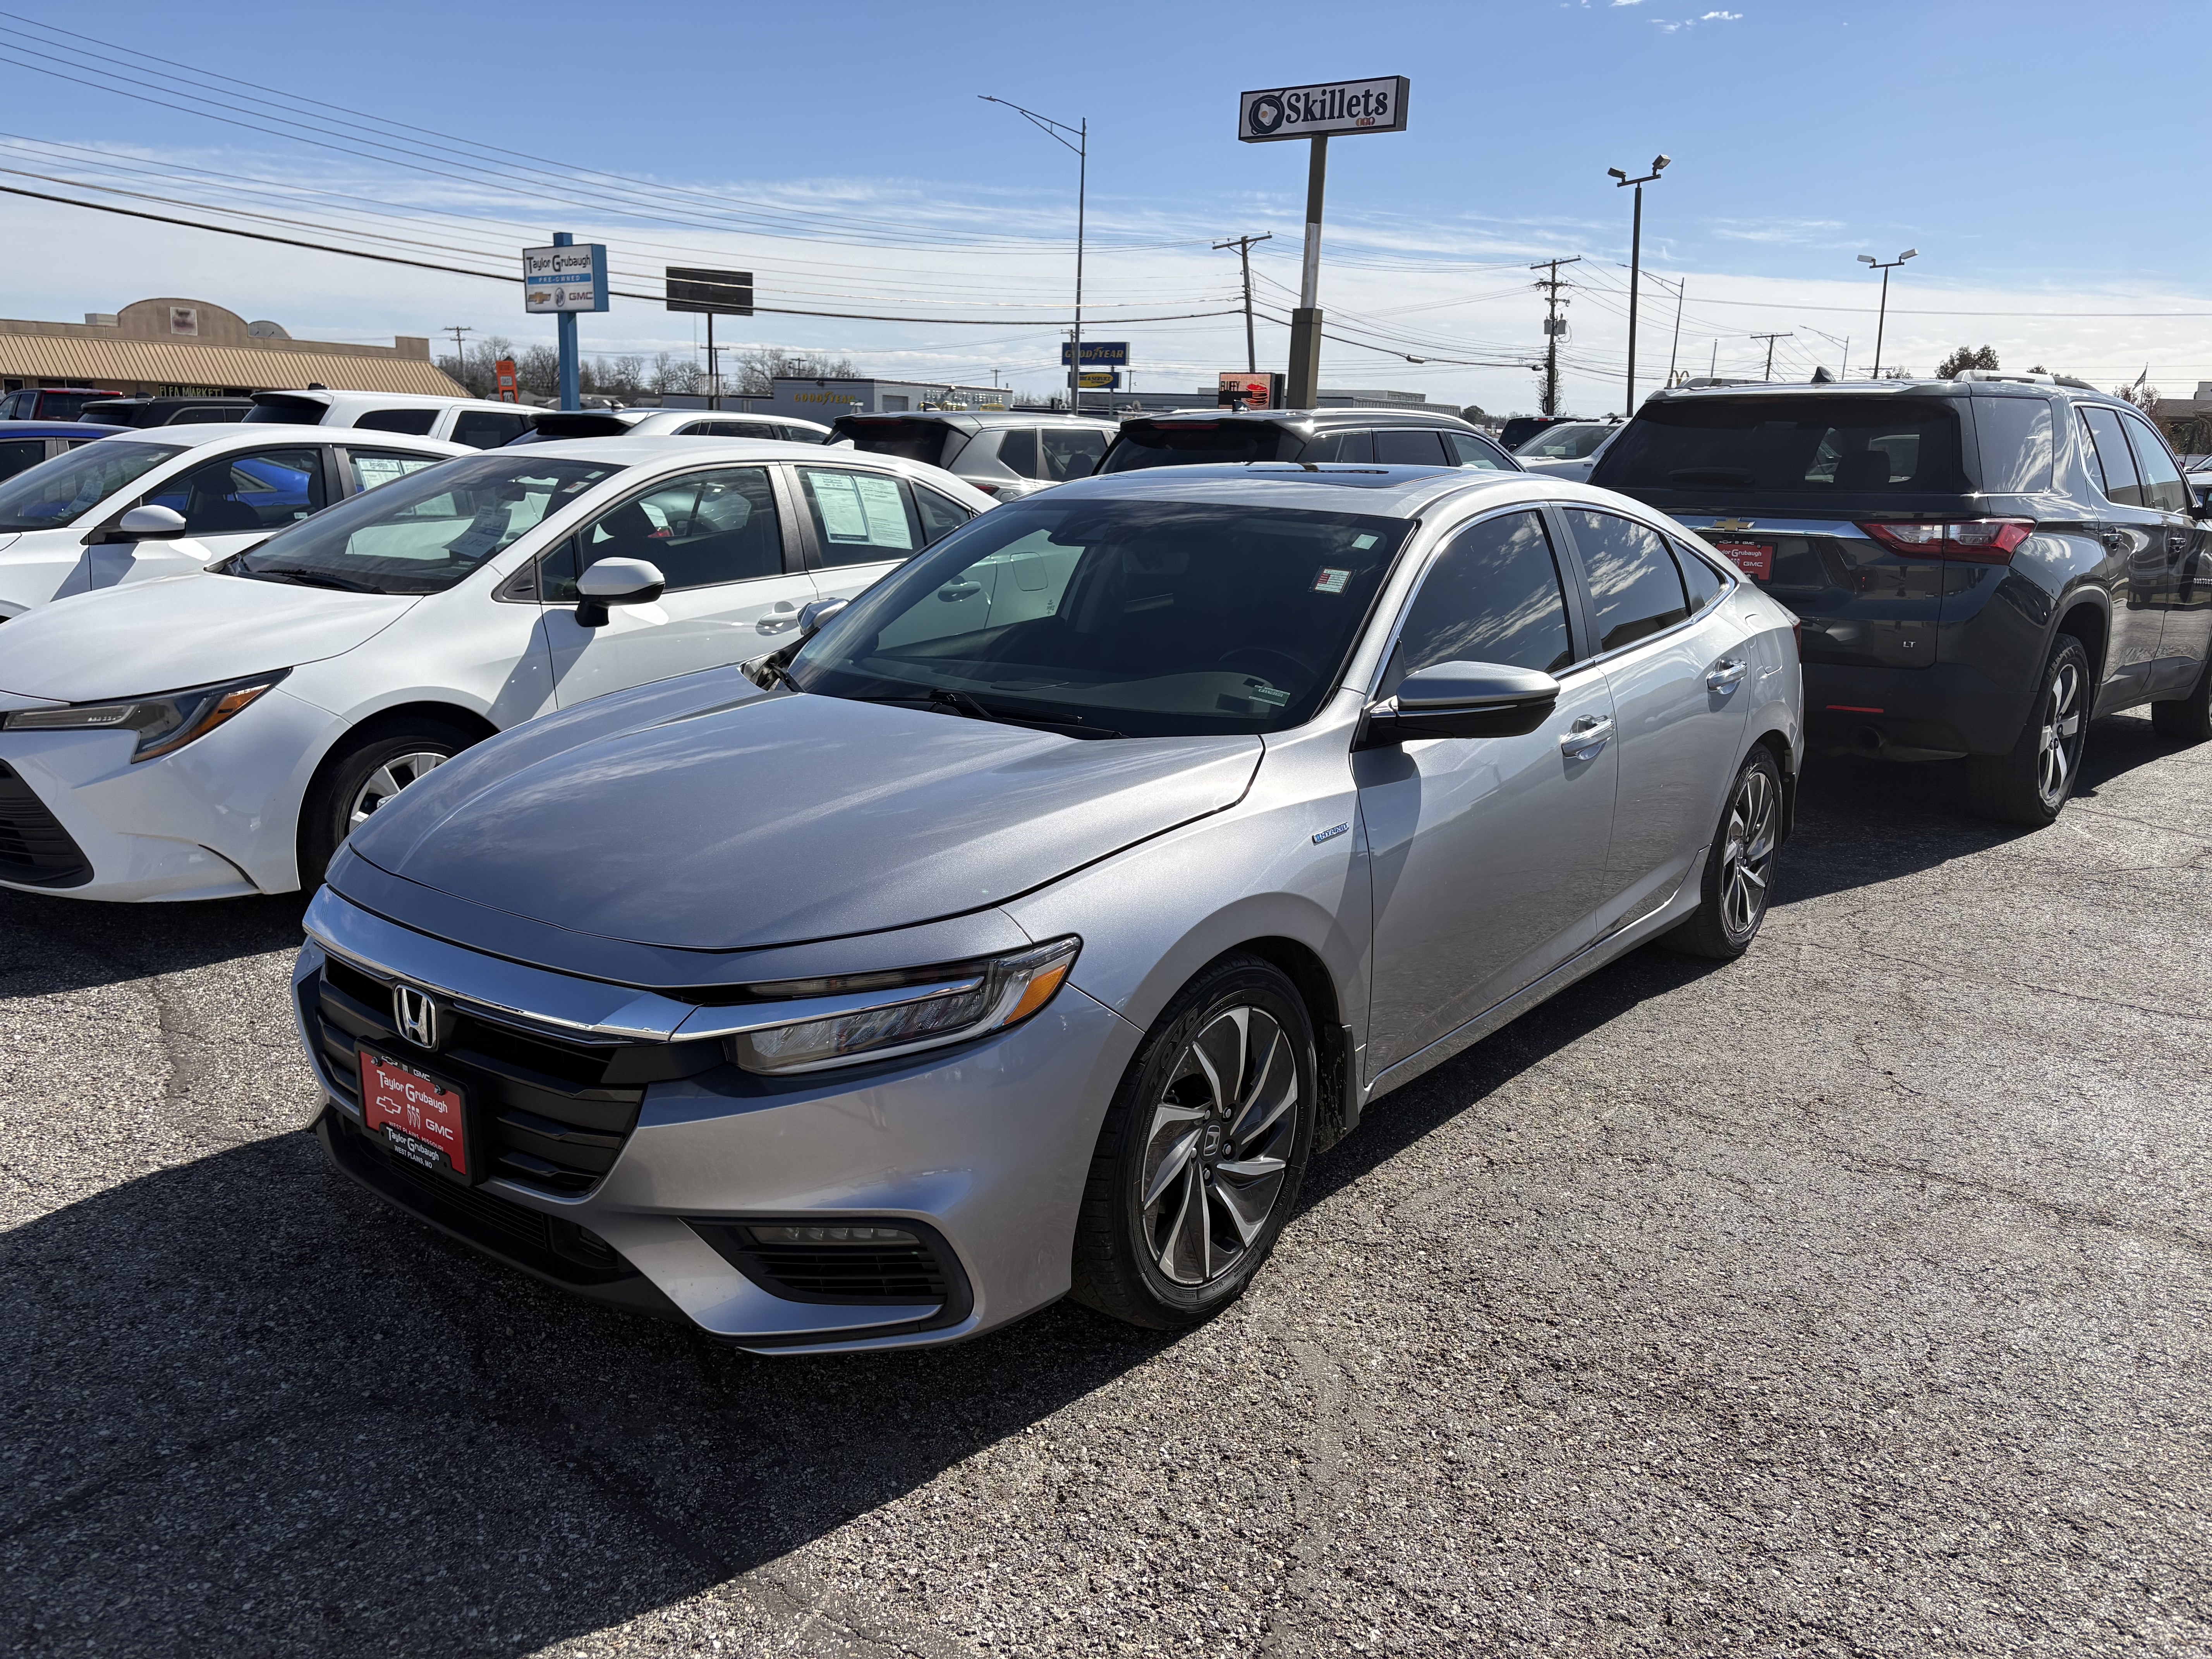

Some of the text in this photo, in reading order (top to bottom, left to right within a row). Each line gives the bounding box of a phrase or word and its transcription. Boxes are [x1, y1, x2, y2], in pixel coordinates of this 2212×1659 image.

[1286, 88, 1388, 124] Skillets
[526, 254, 591, 274] Taylor Grubaugh
[569, 292, 593, 301] GMC
[1065, 349, 1124, 358] GODYEAR
[794, 392, 855, 404] GOODYEAR
[1321, 824, 1347, 839] HYBRID
[413, 1068, 431, 1082] GMC
[376, 1069, 448, 1113] Taylor Grubaugh
[388, 1120, 401, 1130] WEST
[421, 1137, 444, 1152] MISSOURI
[426, 1118, 453, 1140] GMC
[386, 1126, 439, 1161] Taylor Grubaugh
[394, 1144, 433, 1169] WEST PLAINS, MO
